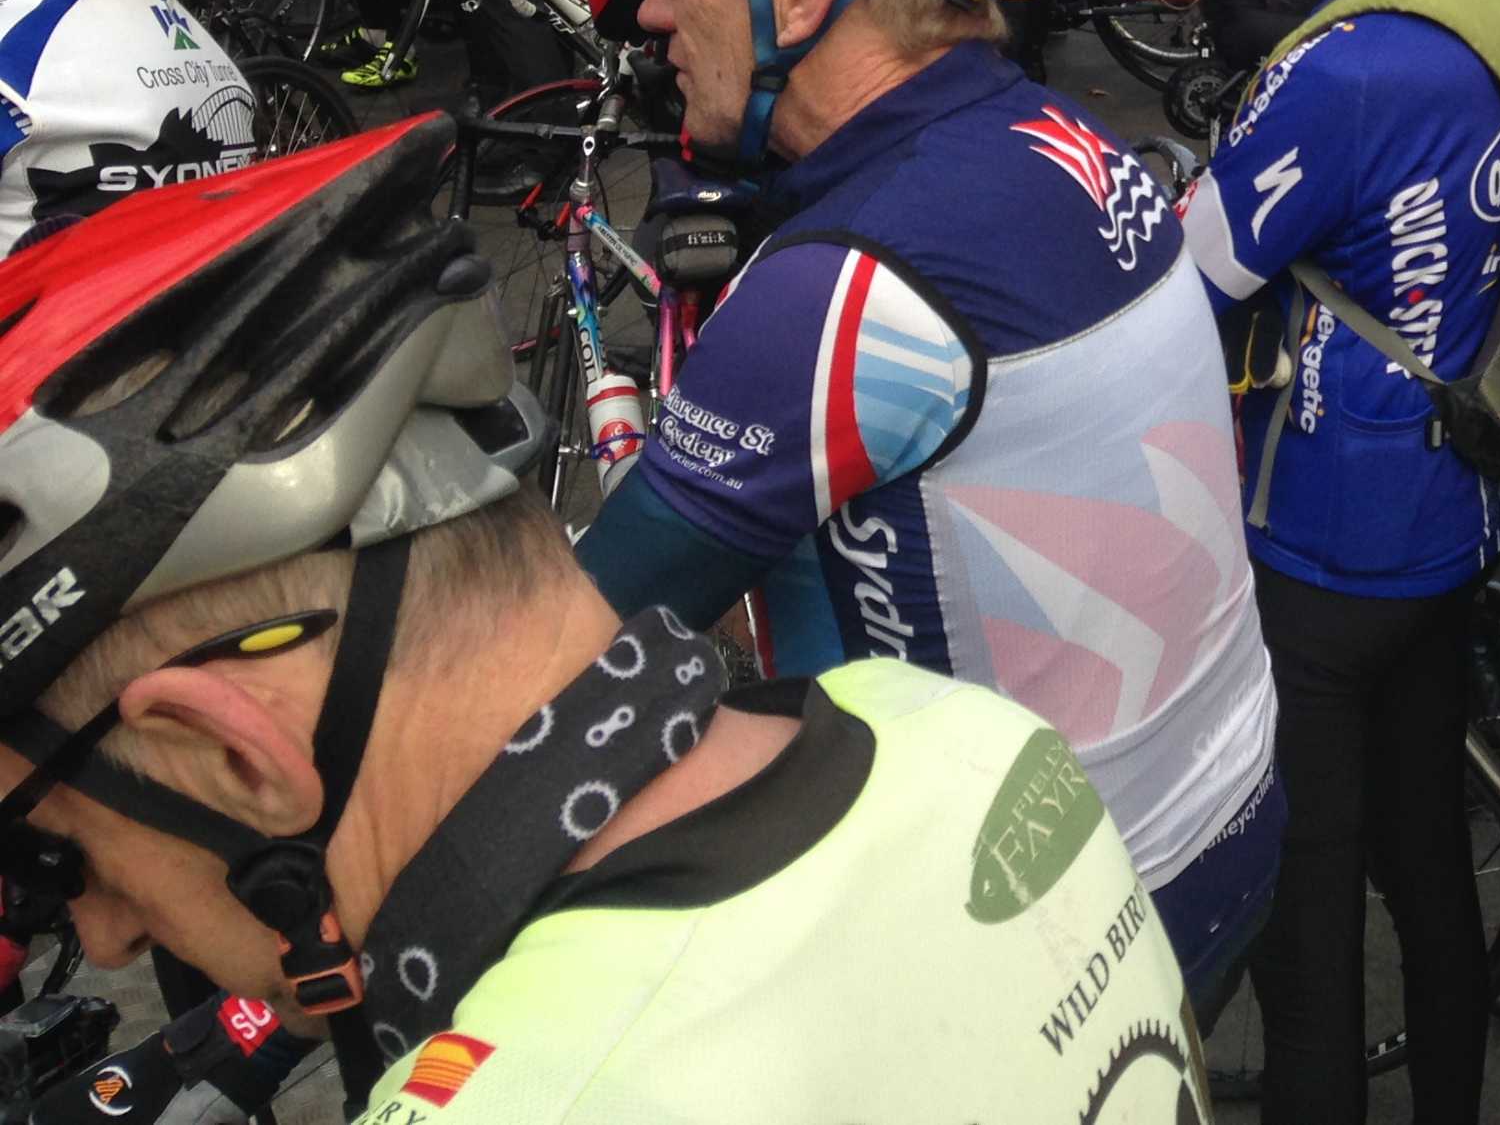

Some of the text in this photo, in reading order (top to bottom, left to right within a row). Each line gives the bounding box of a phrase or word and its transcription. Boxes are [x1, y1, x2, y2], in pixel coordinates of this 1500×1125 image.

[136, 64, 186, 89] Cross
[184, 60, 211, 87] City
[660, 415, 736, 468] Cyclery
[739, 424, 776, 455] St
[1040, 951, 1111, 1057] WILD
